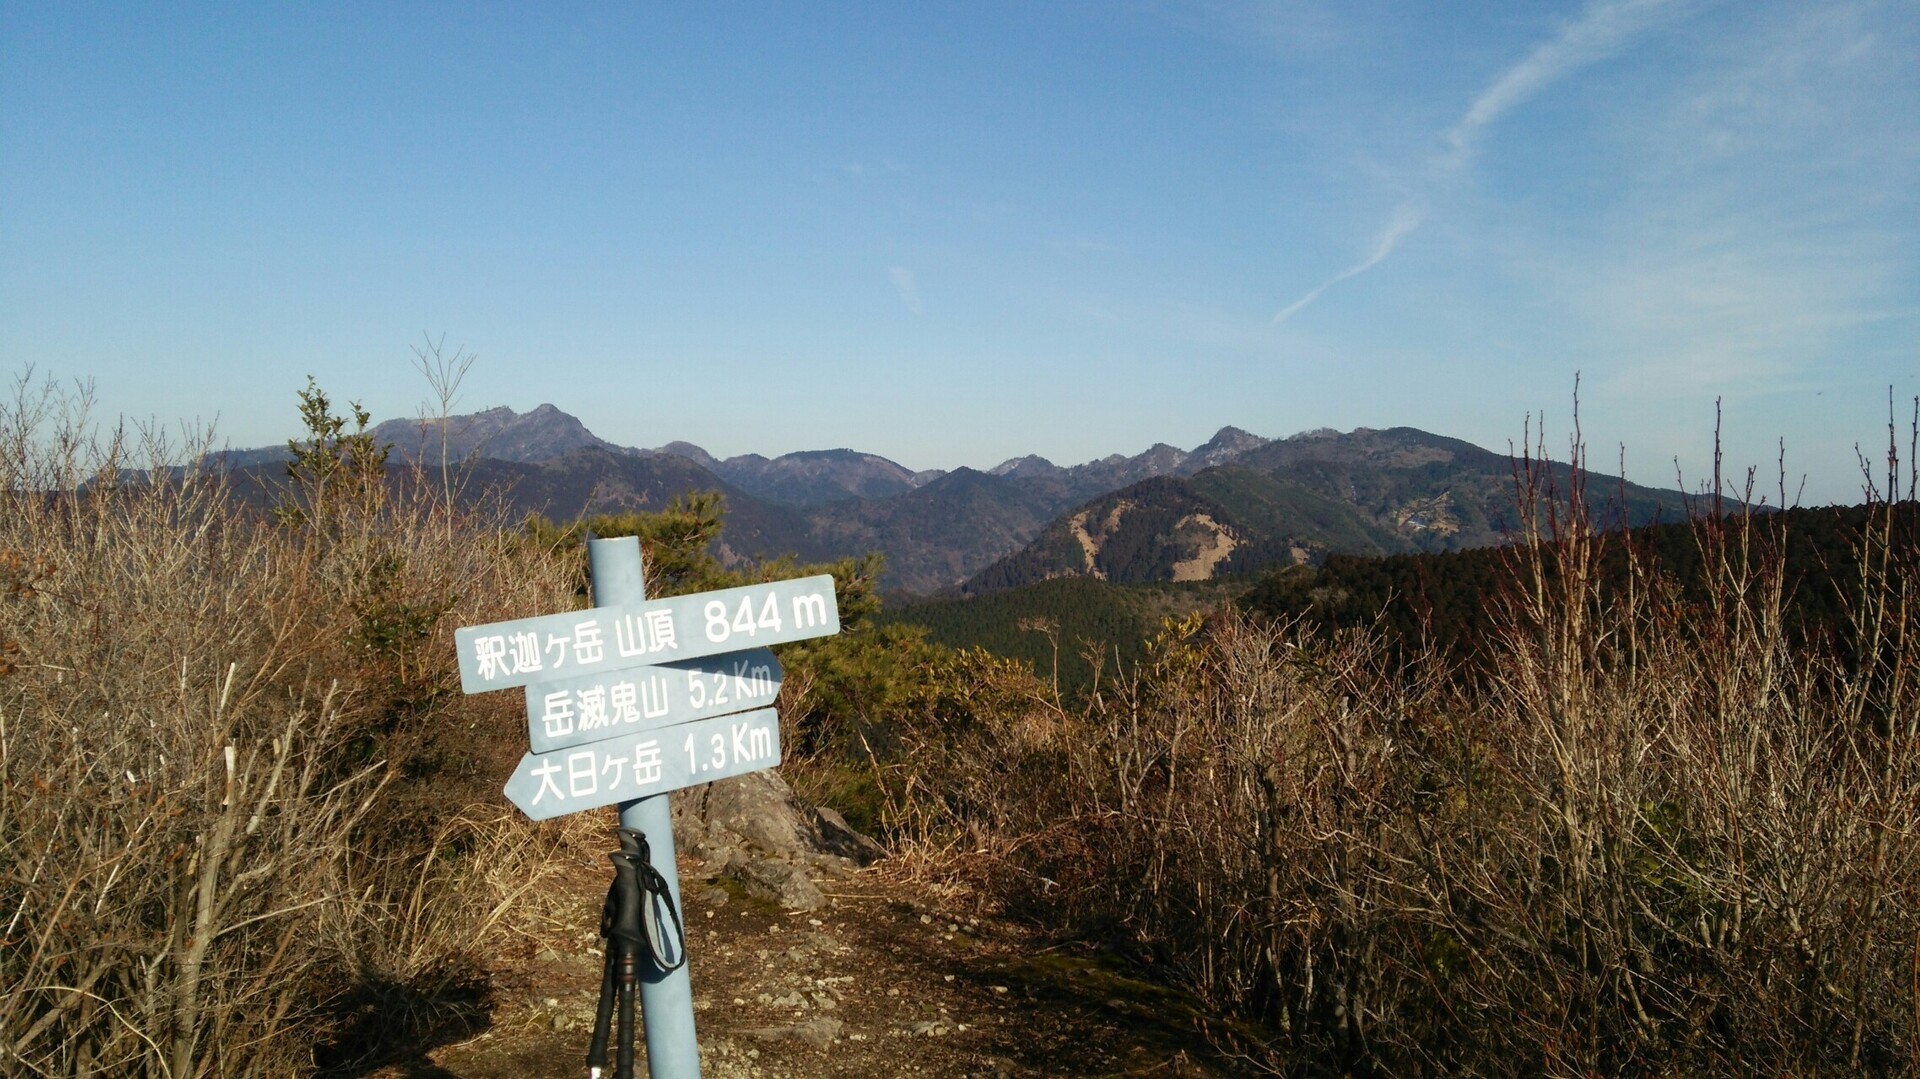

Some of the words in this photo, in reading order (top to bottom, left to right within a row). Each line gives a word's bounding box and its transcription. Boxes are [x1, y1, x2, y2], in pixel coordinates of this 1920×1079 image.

[615, 608, 678, 658] 山頂
[704, 591, 782, 643] 844
[792, 592, 827, 630] m
[542, 674, 669, 738] 岳滅鬼山
